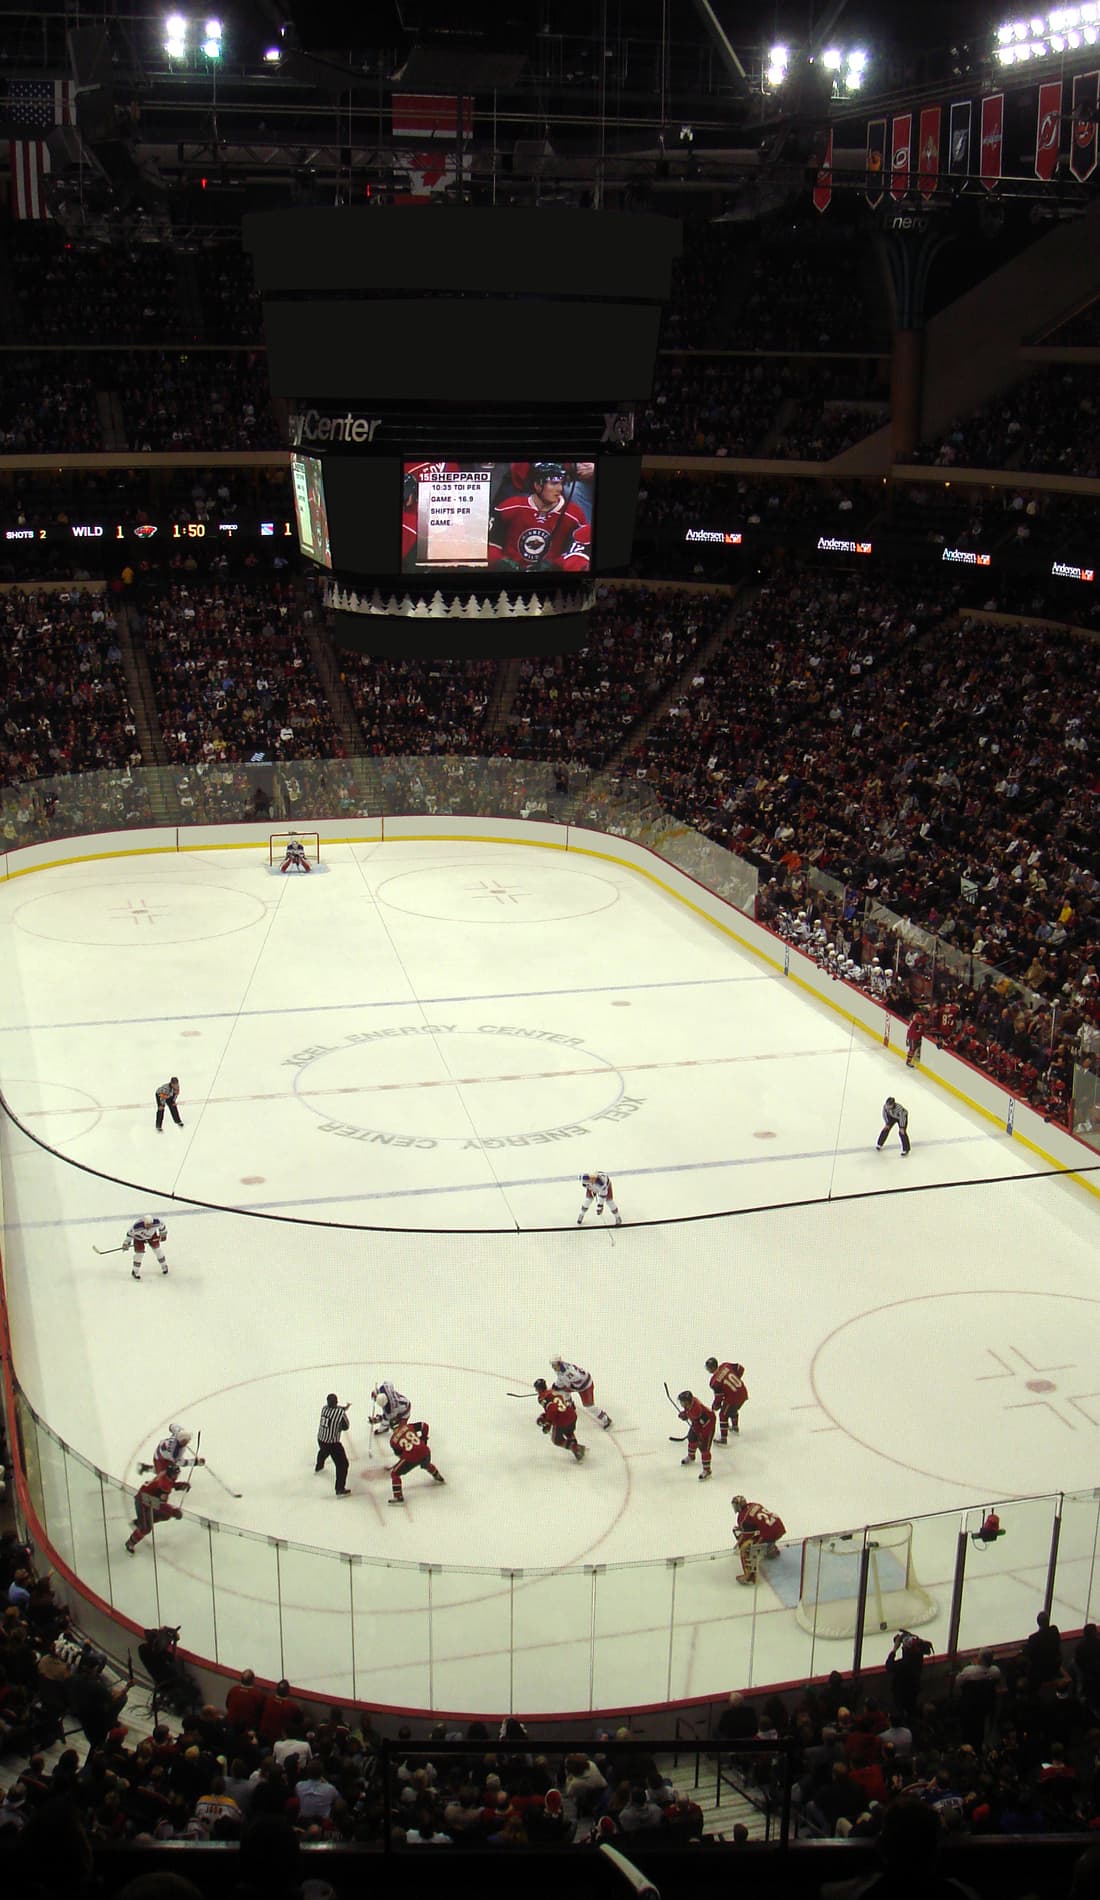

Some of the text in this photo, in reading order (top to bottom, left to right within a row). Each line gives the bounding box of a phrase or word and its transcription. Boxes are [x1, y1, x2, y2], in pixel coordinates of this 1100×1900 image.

[304, 409, 383, 443] Center
[420, 473, 489, 481] 15 SHEPPARD
[431, 495, 452, 503] GAME
[430, 507, 471, 515] SHIFTS PER
[6, 530, 34, 539] SHOTS
[40, 530, 47, 539] 2
[72, 526, 103, 537] WILD
[116, 525, 124, 539] 1
[173, 524, 206, 538] 1:50
[283, 522, 292, 536] 1
[686, 528, 724, 541] Andersen
[817, 537, 856, 550] Andersen
[942, 547, 977, 561] Andersen
[281, 1024, 585, 1067] XCEL ENERGY CENTER
[316, 1095, 648, 1150] XCEL ENERGY CENTER
[723, 1373, 743, 1392] 10
